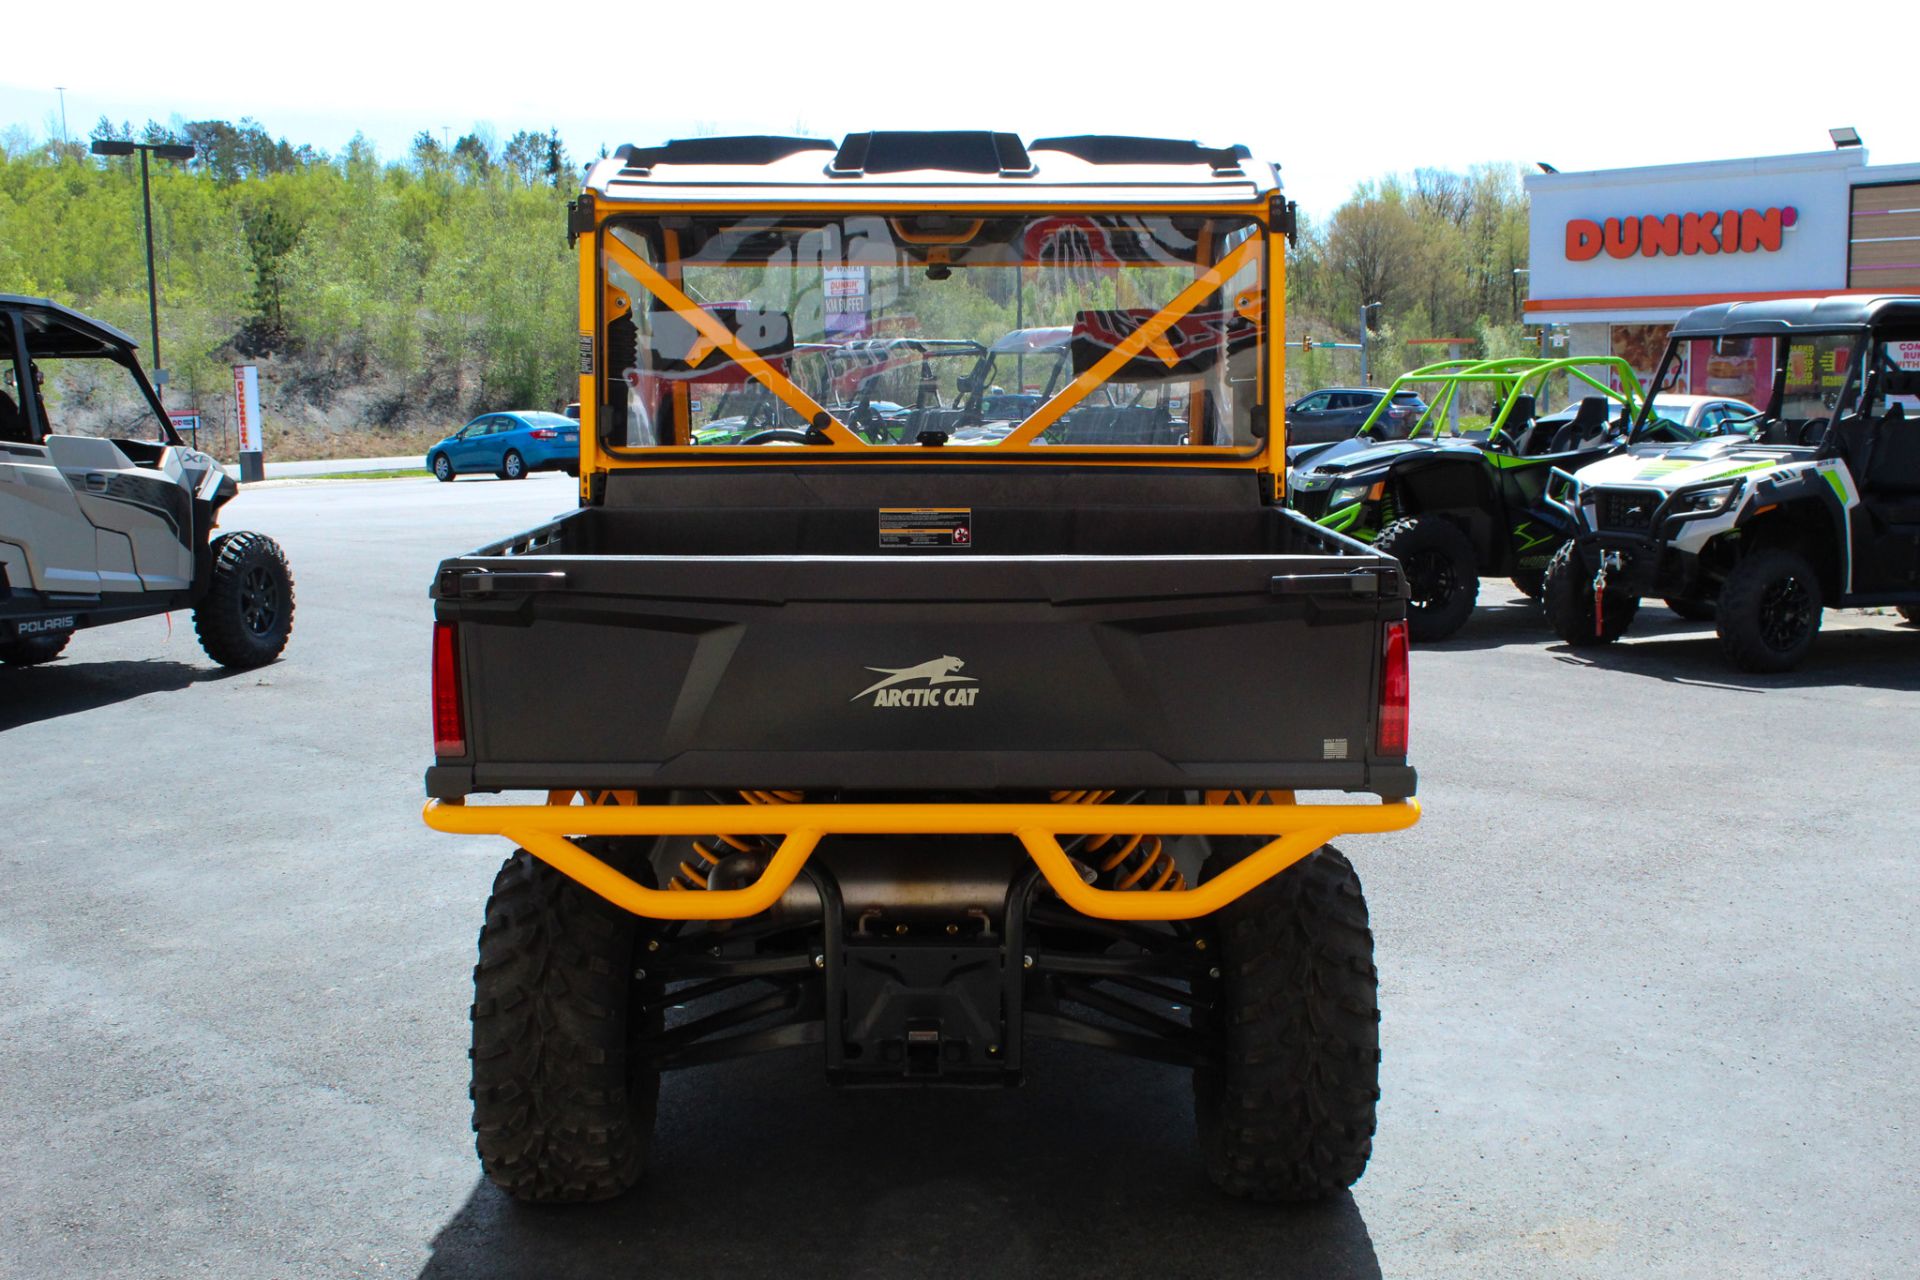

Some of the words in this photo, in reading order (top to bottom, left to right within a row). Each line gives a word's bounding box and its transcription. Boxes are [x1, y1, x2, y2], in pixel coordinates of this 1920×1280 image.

[1565, 206, 1798, 262] DUNKIN'
[18, 616, 74, 634] POLARIS
[873, 688, 941, 707] ARCTIC
[943, 688, 980, 707] CAT
